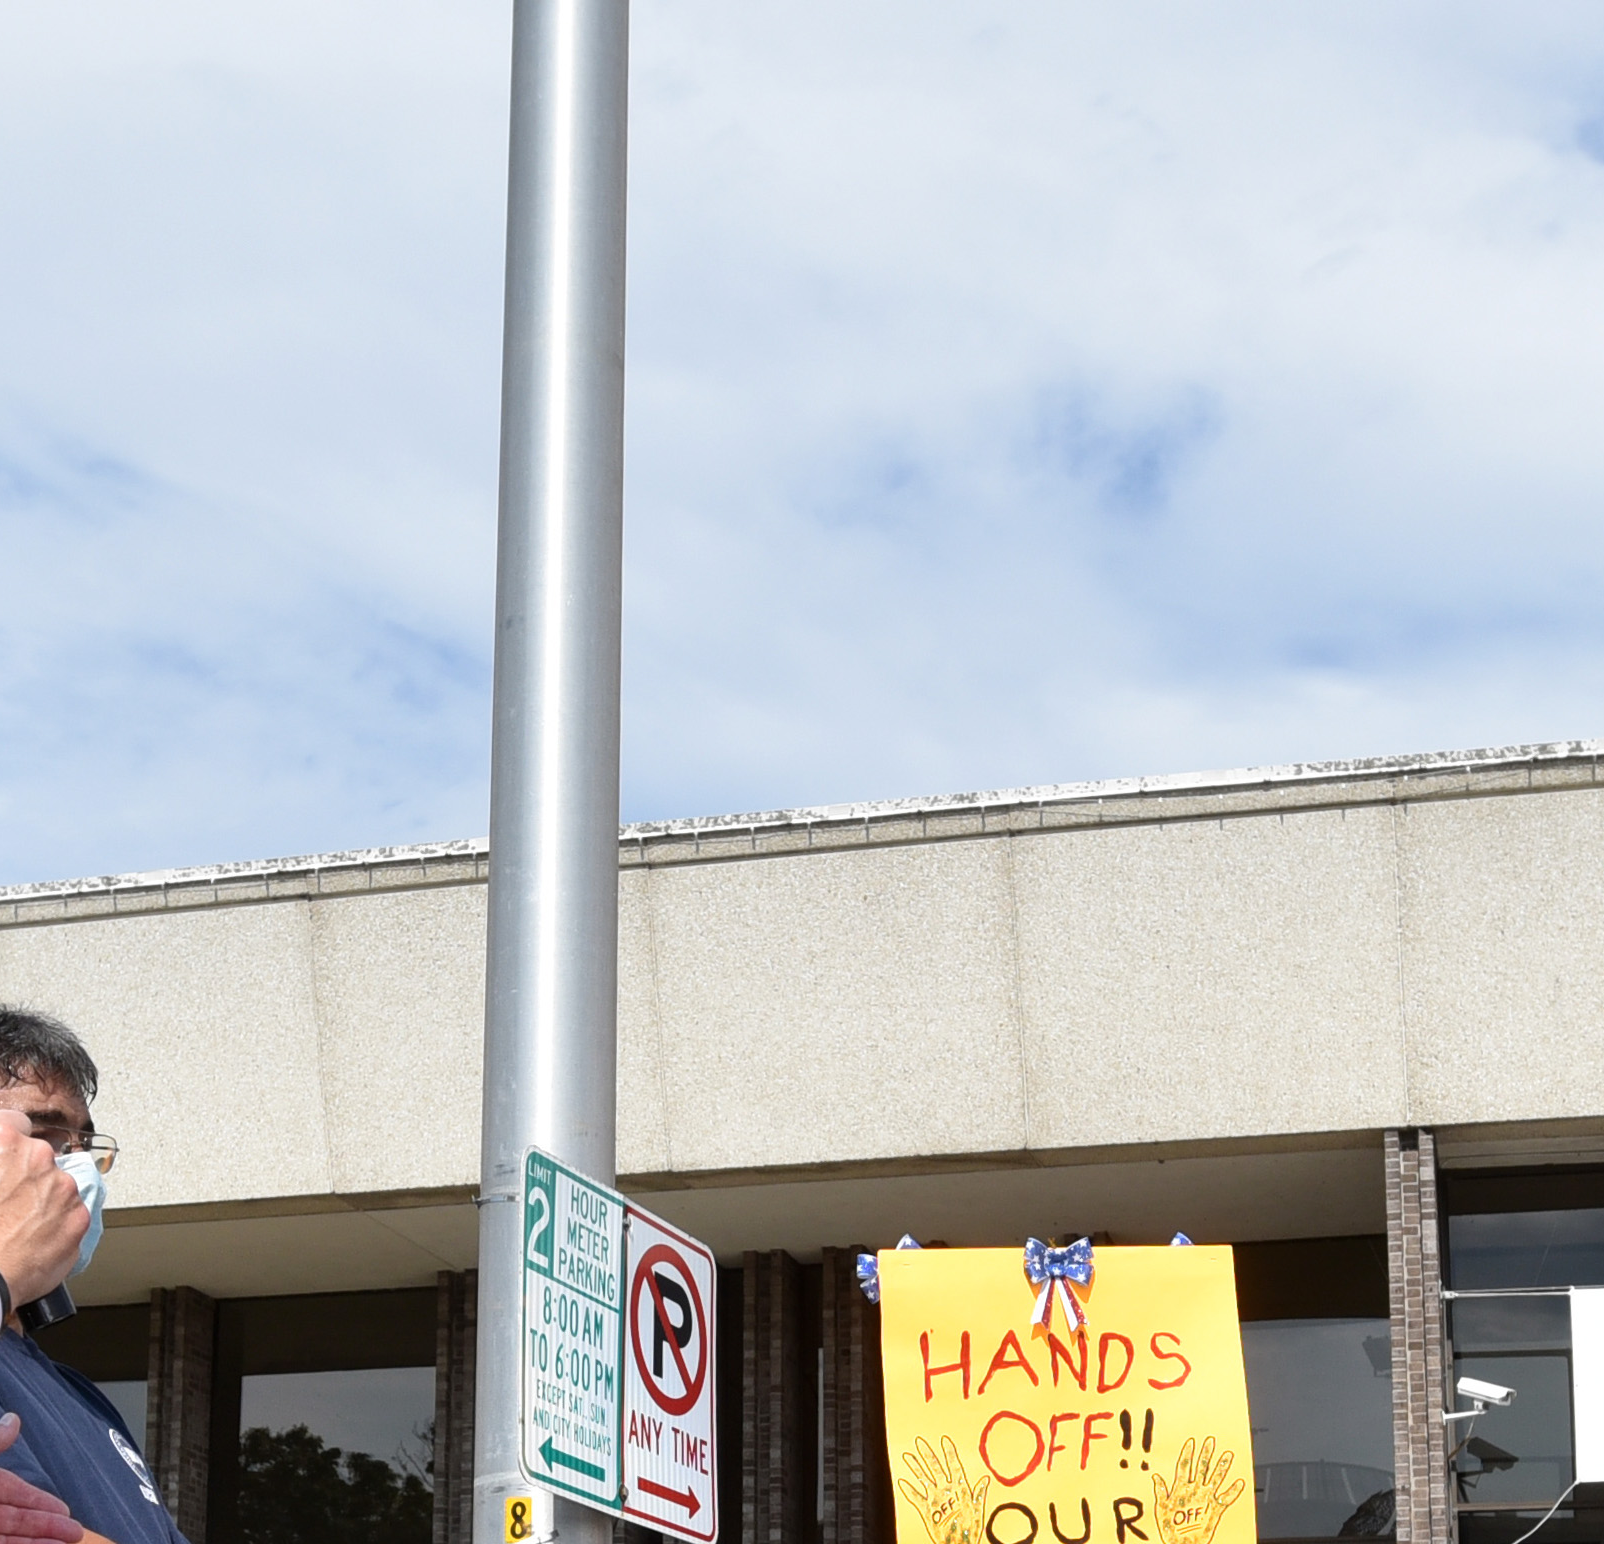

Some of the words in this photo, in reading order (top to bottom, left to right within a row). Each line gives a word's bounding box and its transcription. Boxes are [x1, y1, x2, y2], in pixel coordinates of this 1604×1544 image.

[528, 1160, 552, 1186] LIMIT
[527, 1186, 550, 1270] 2
[571, 1184, 608, 1231] HOUR
[567, 1217, 610, 1265] METER
[559, 1247, 616, 1302] PARKING
[543, 1286, 579, 1338] 8:00
[583, 1307, 603, 1351] AM
[530, 1328, 548, 1373] TO
[555, 1343, 590, 1392] 6:00
[595, 1359, 614, 1403] PM
[919, 1329, 1192, 1403] HANDS
[536, 1379, 566, 1410] EXCEPT
[533, 1406, 550, 1430] AND
[553, 1414, 571, 1440] CITY
[573, 1423, 612, 1457] HOLIDAYS
[628, 1410, 663, 1456] ANY
[671, 1427, 709, 1476] TIME
[979, 1408, 1154, 1487] OFF!!
[510, 1501, 527, 1540] 8
[1172, 1503, 1211, 1527] OFF!
